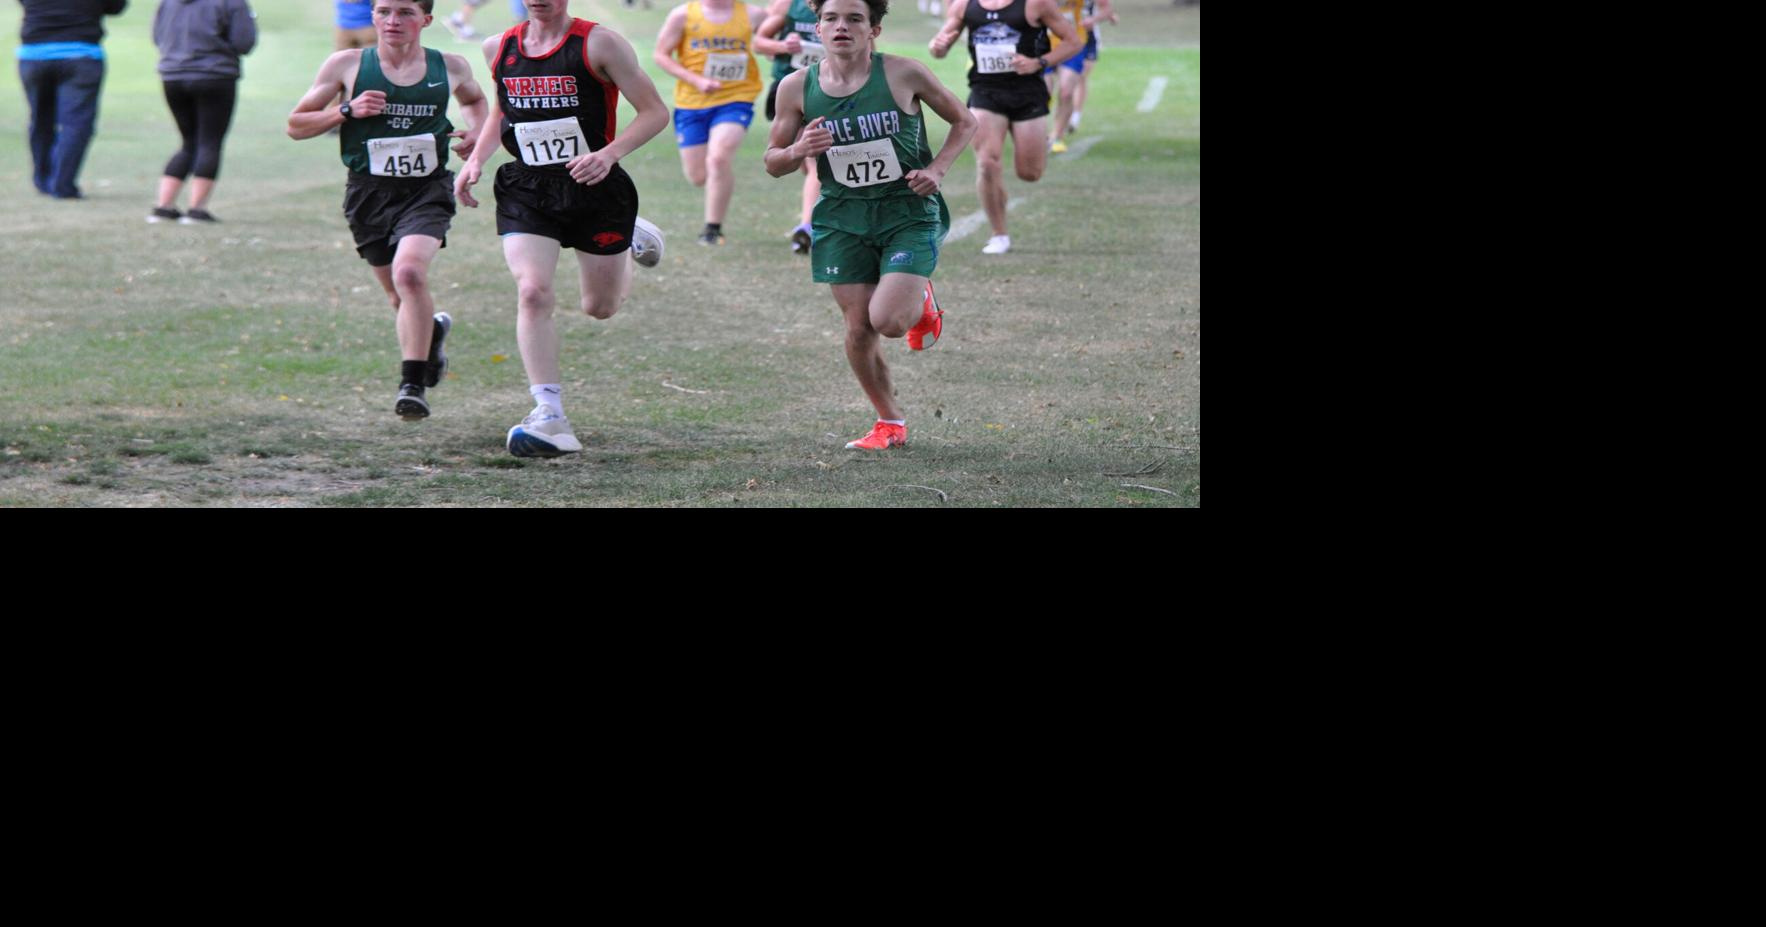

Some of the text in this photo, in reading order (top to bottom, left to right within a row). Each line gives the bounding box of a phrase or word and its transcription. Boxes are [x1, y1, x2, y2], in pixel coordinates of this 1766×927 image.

[502, 75, 578, 97] NRHEG
[382, 103, 438, 116] RIBAULT
[508, 96, 580, 109] PANTHERS
[816, 110, 900, 142] PLE RIVER
[526, 135, 579, 162] 1127
[384, 153, 427, 176] 454
[846, 159, 890, 184] 472
